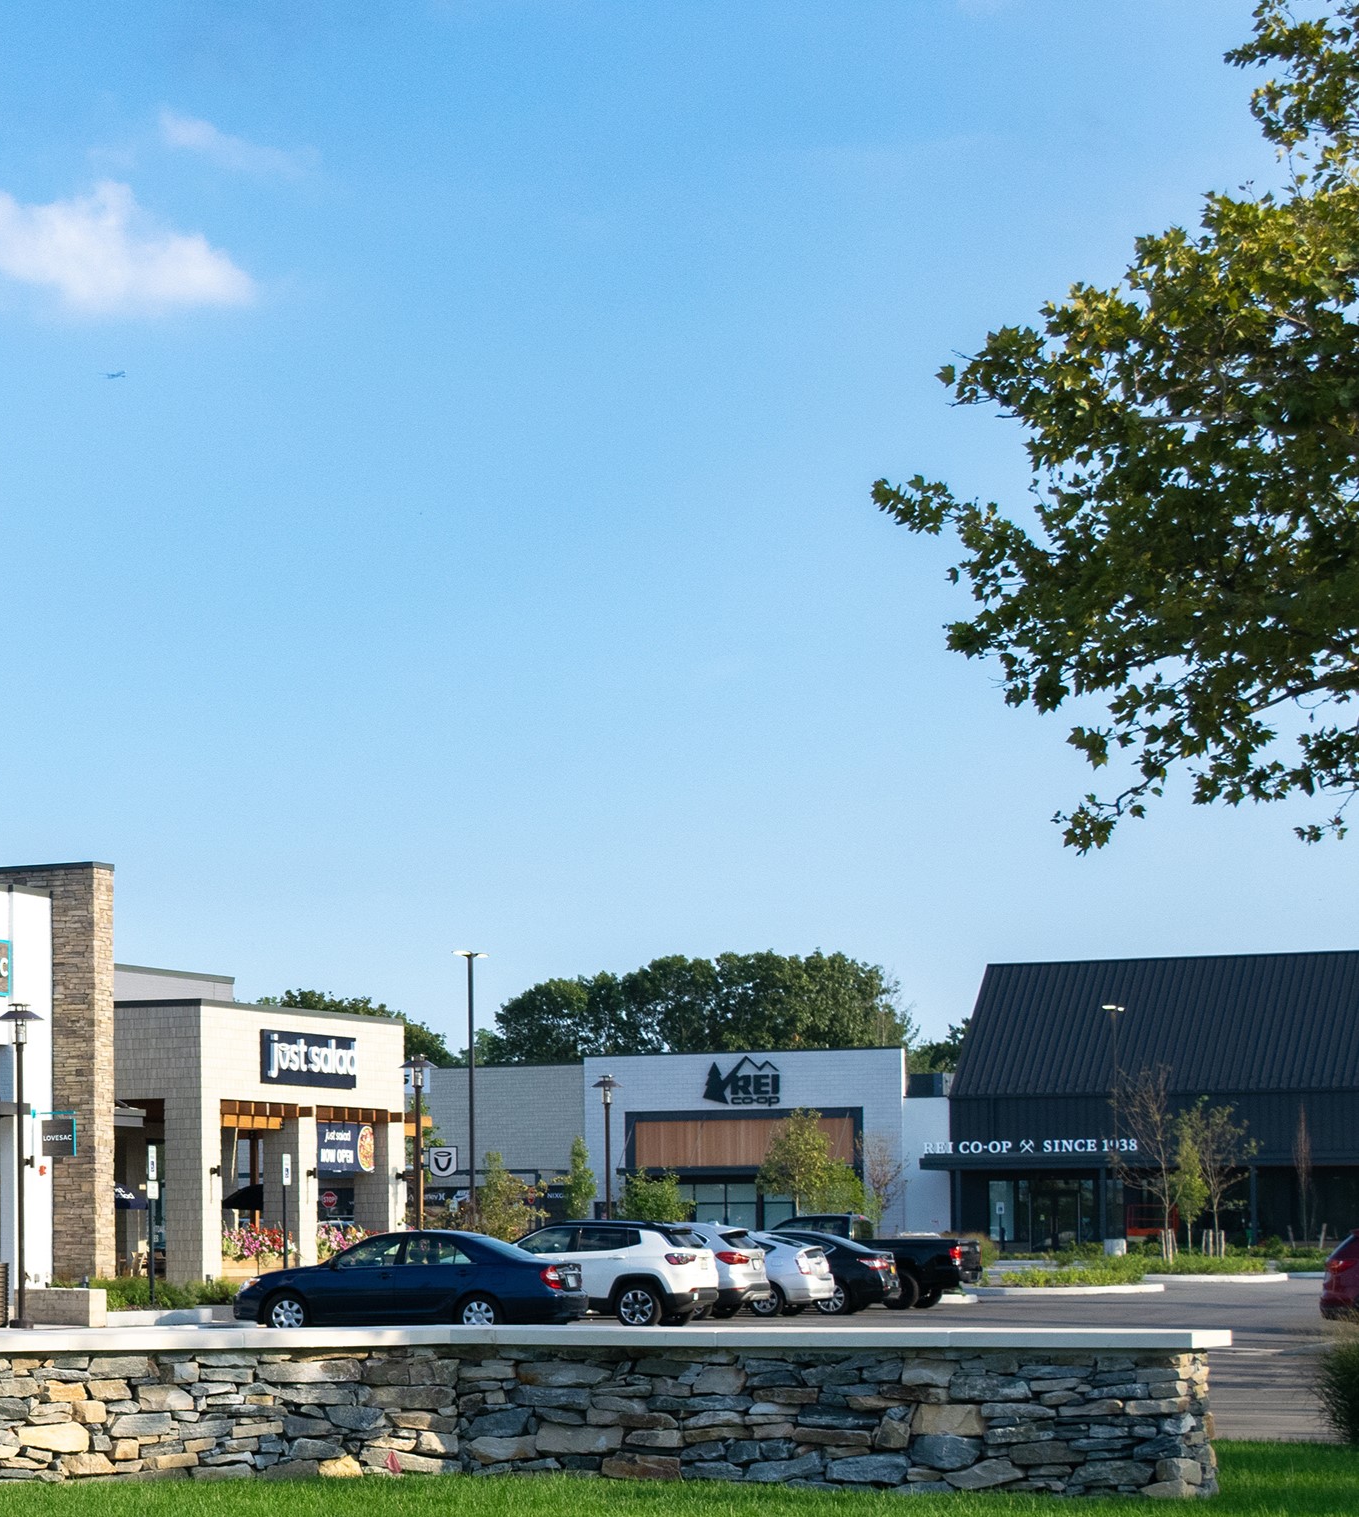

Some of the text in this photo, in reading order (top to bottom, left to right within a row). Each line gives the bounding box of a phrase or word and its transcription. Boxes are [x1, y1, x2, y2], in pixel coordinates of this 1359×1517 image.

[267, 1033, 357, 1078] just salad
[730, 1073, 780, 1095] REI
[730, 1096, 780, 1107] co-op
[42, 1134, 72, 1142] LOVESAC
[324, 1129, 351, 1143] just salad
[923, 1141, 954, 1154] REI
[958, 1140, 1012, 1154] CO-OP
[1042, 1139, 1098, 1153] SINCE
[320, 1148, 354, 1164] NOW OPEN
